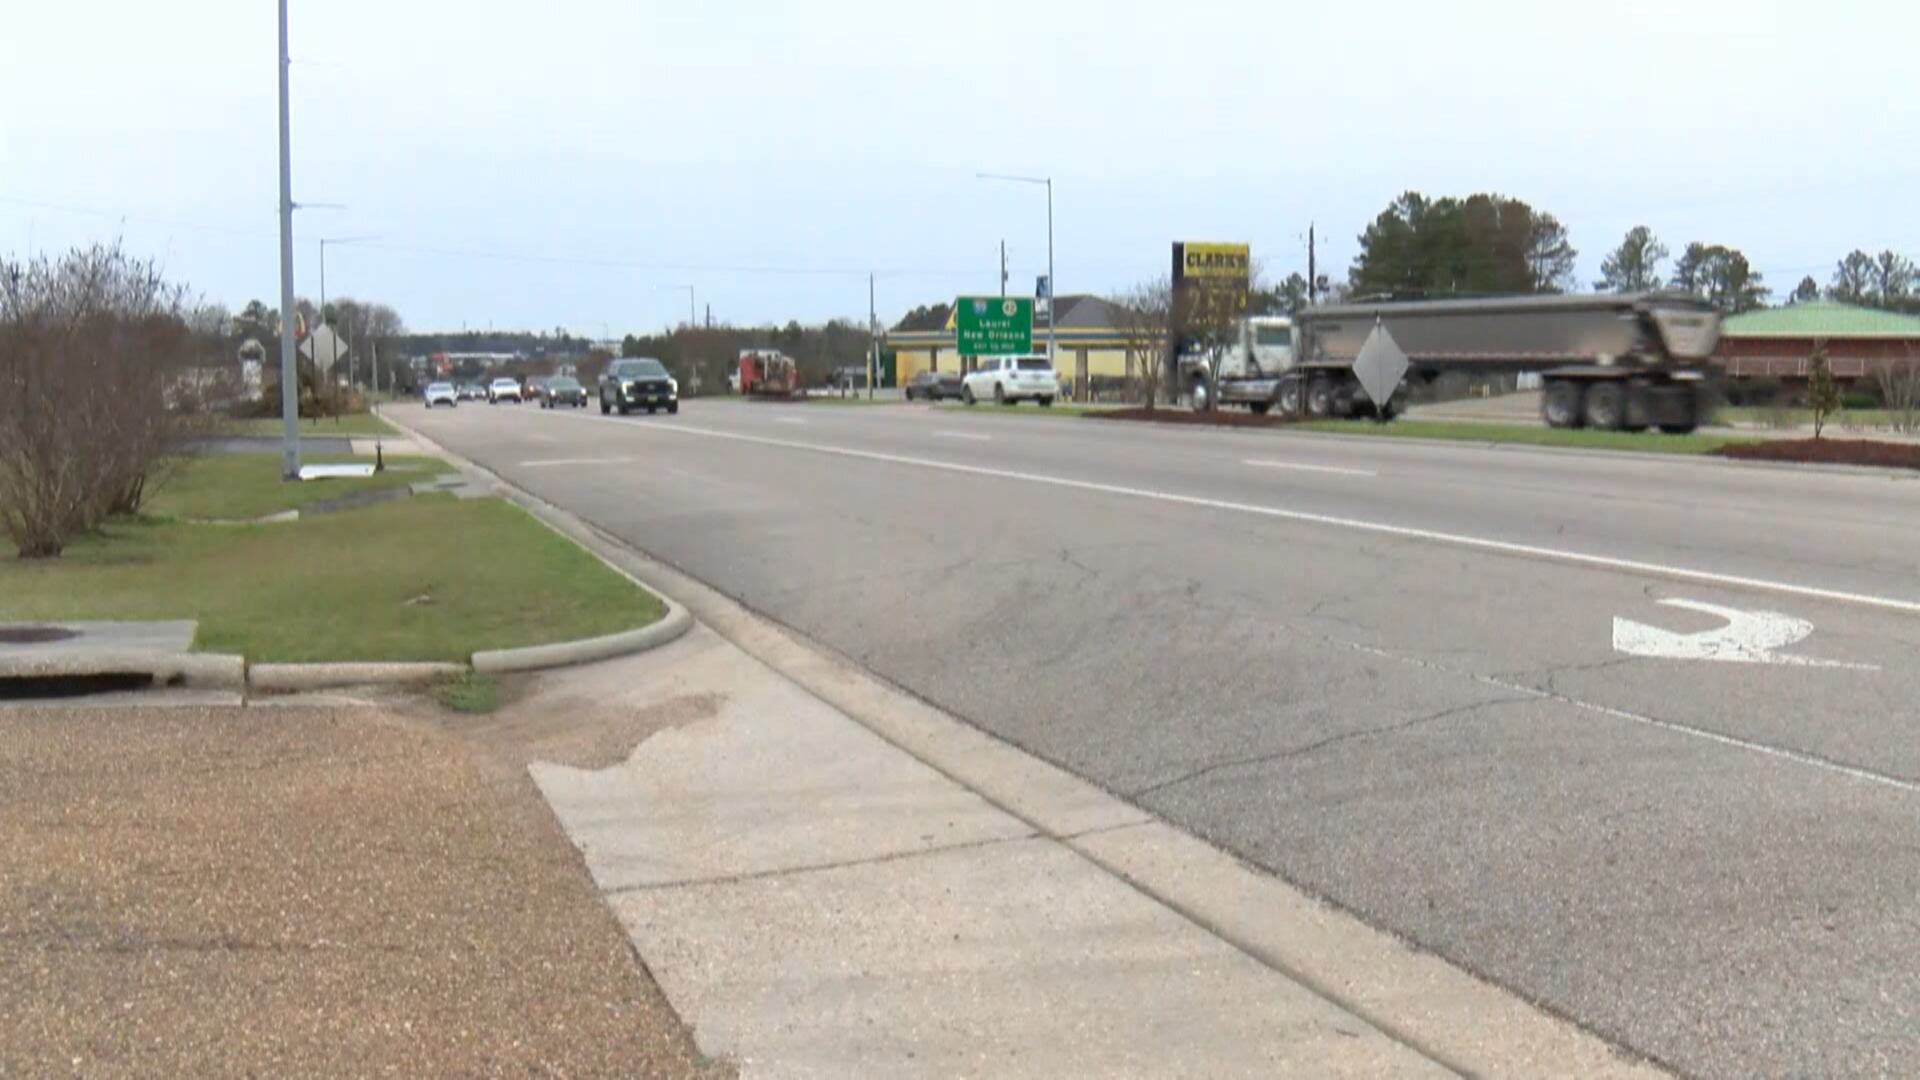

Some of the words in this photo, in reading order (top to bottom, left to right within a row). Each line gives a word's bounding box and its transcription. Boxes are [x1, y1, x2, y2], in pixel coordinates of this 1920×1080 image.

[979, 319, 1011, 329] Laurel
[963, 330, 983, 340] New
[988, 330, 1025, 340] Orleans
